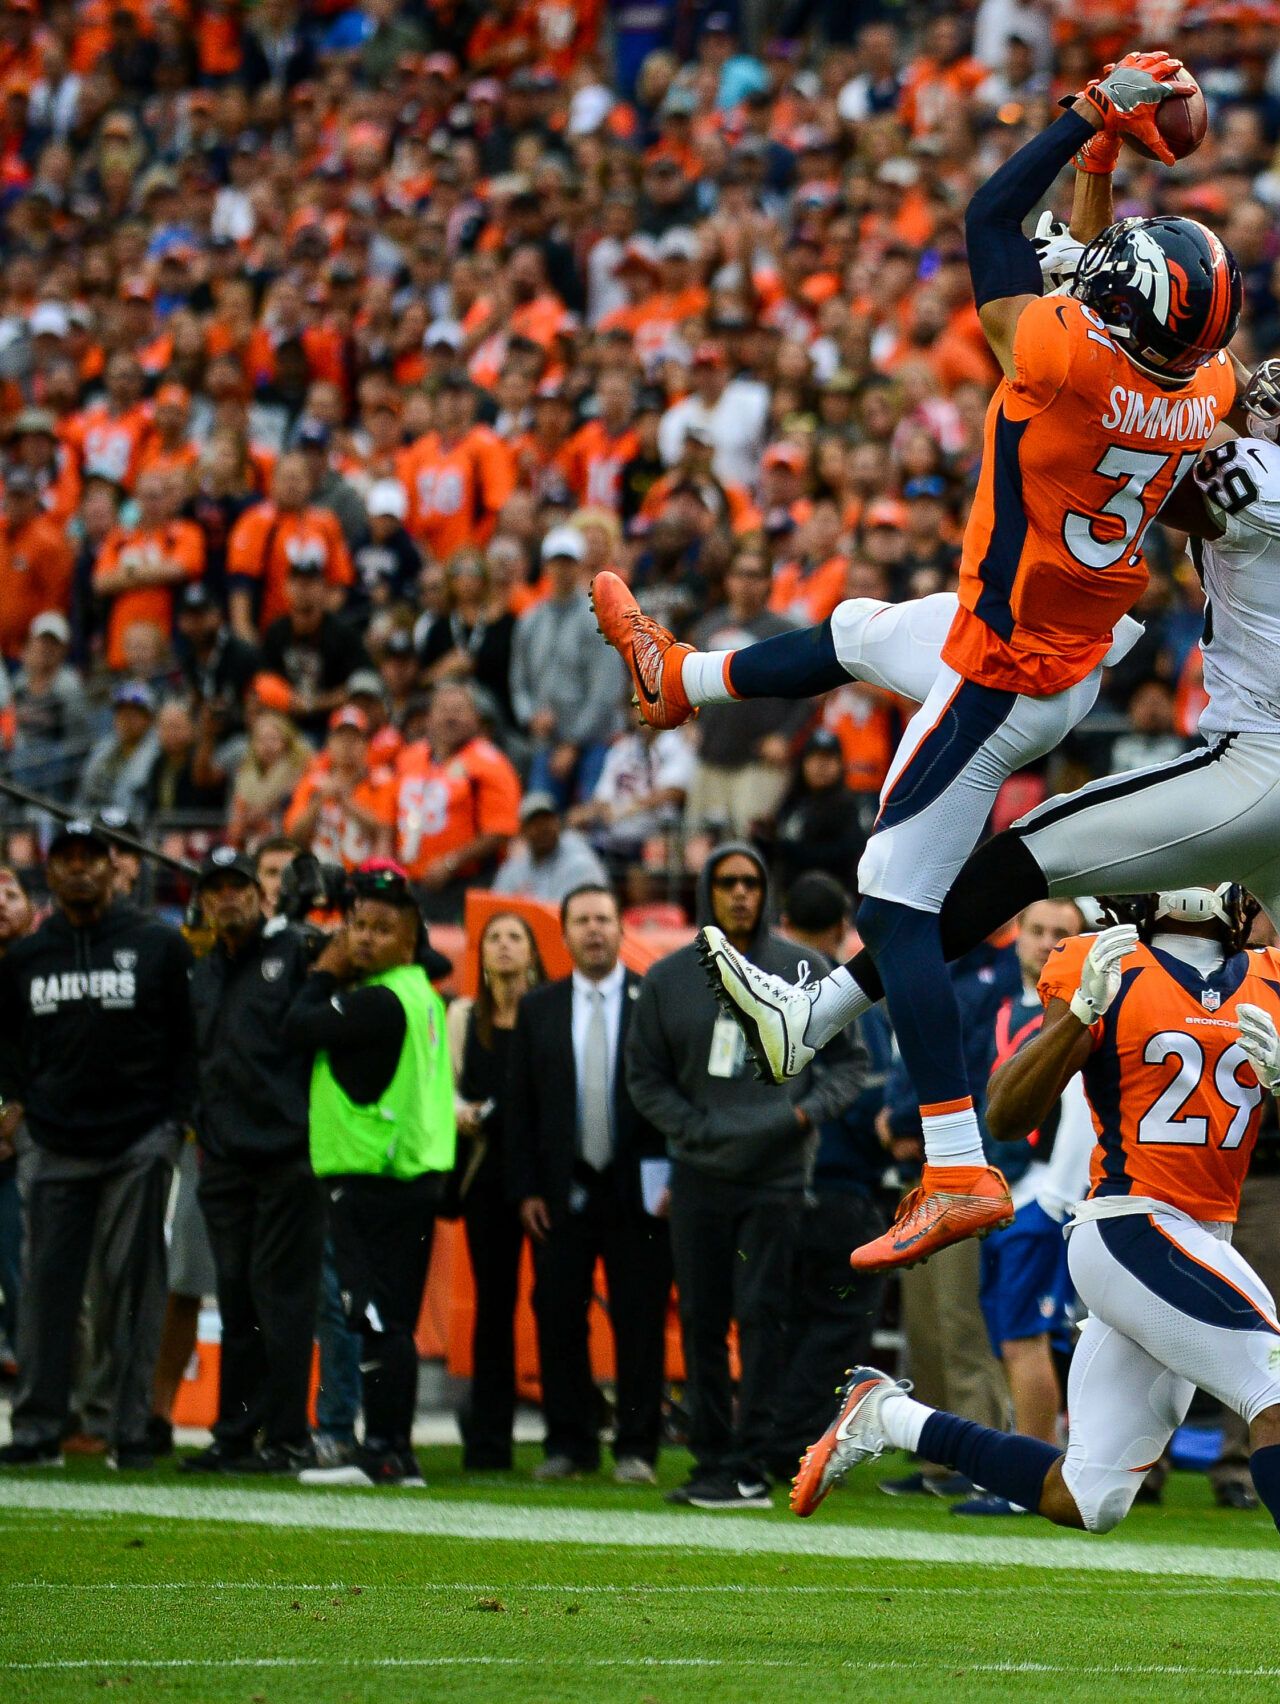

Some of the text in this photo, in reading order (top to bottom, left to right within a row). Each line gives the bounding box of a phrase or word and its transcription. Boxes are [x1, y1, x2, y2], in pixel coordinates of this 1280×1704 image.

[1101, 385, 1217, 442] SIMMONS
[31, 969, 136, 1008] RAIDERS
[1137, 1030, 1263, 1150] 29
